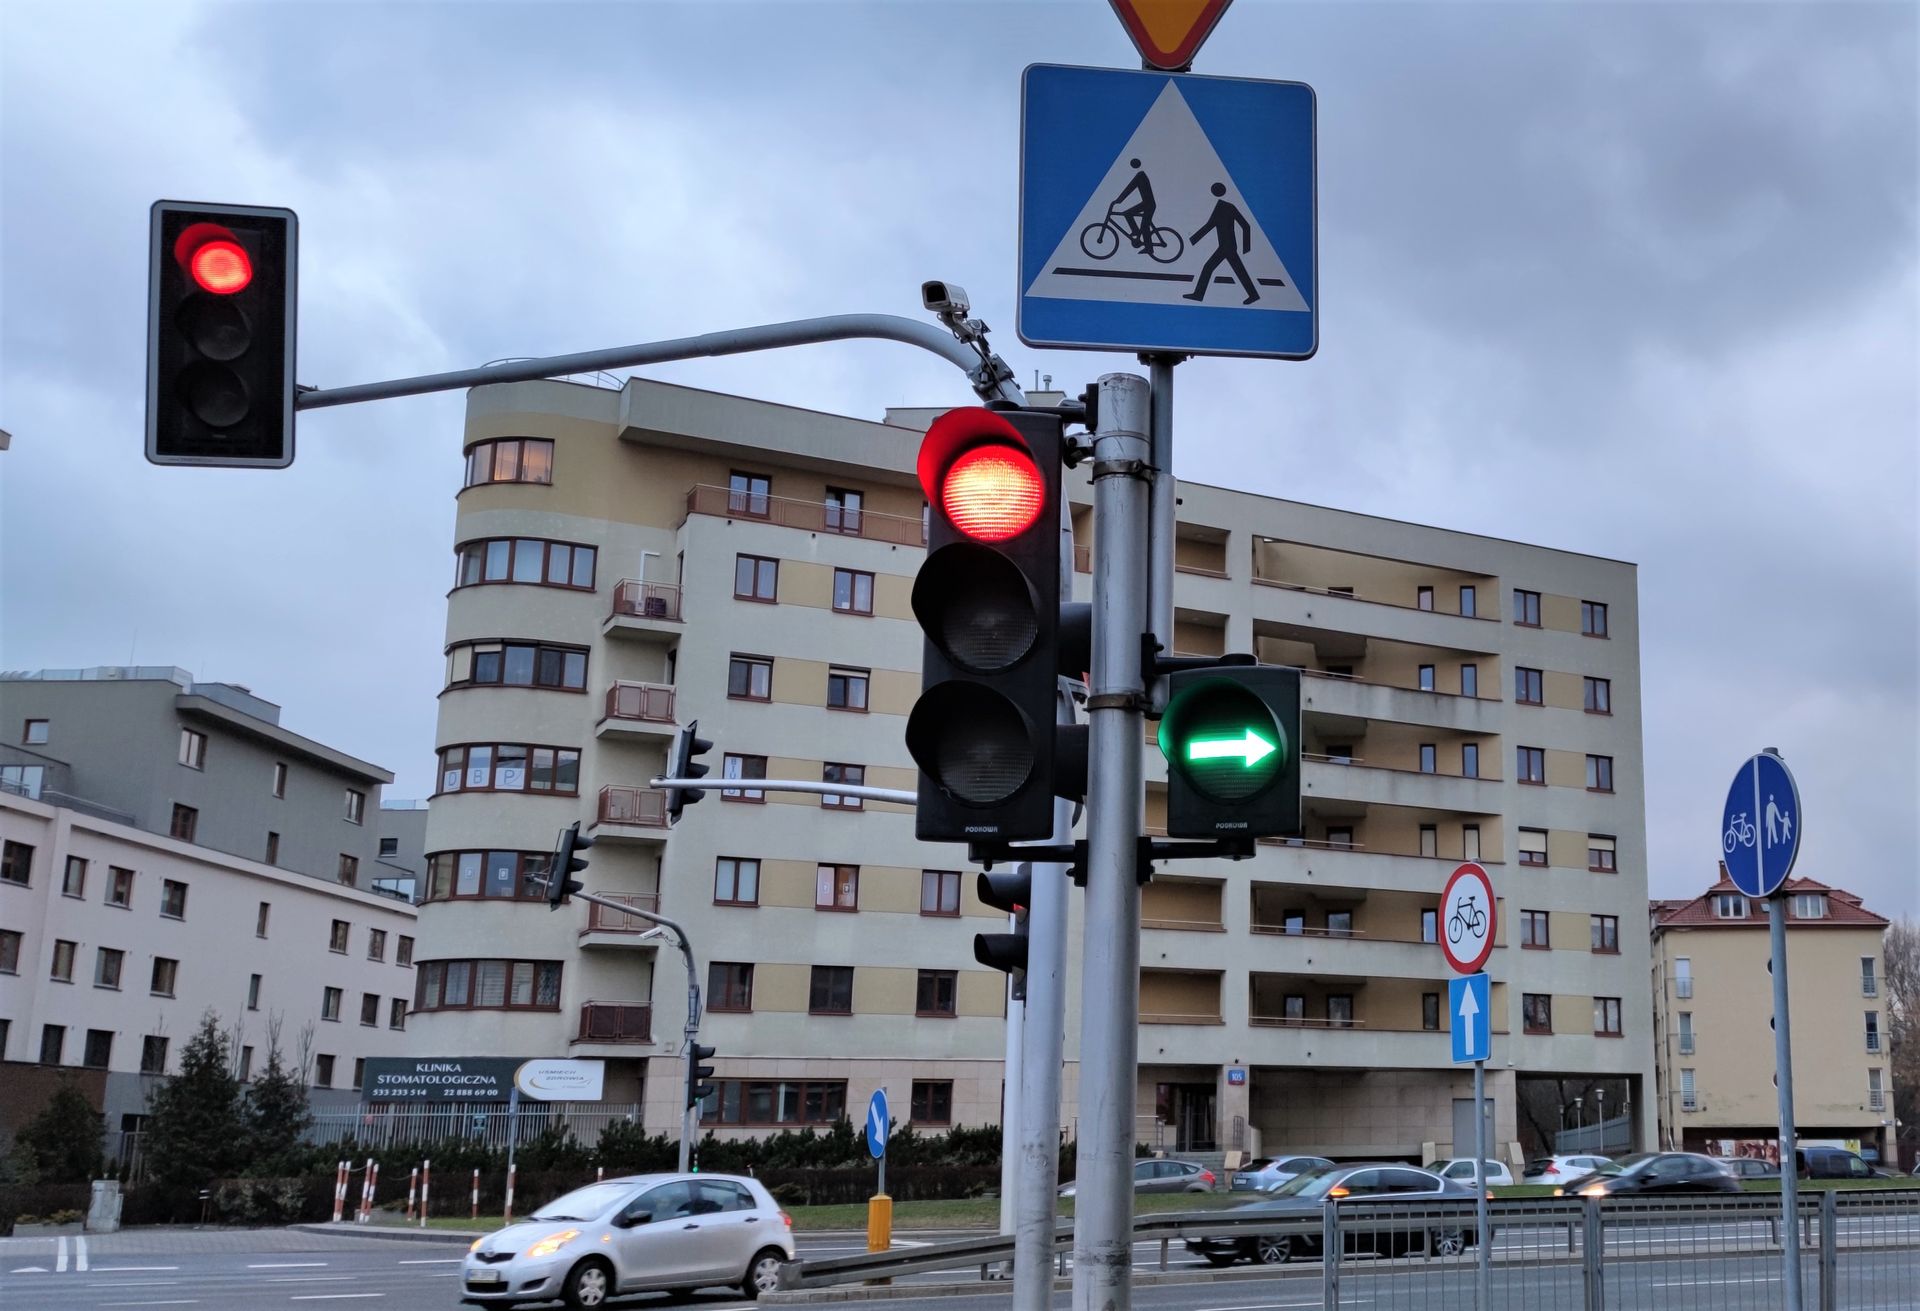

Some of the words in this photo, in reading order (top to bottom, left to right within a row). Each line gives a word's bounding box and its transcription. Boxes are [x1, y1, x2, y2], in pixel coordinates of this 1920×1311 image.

[416, 1063, 462, 1073] KLINIKA
[377, 1074, 497, 1085] STOMATOLOGICZNA
[372, 1088, 390, 1096] 533
[391, 1088, 408, 1096] 233
[409, 1088, 427, 1096] 514
[443, 1088, 455, 1096] 22
[474, 1088, 486, 1096] 69
[487, 1088, 499, 1096] 00
